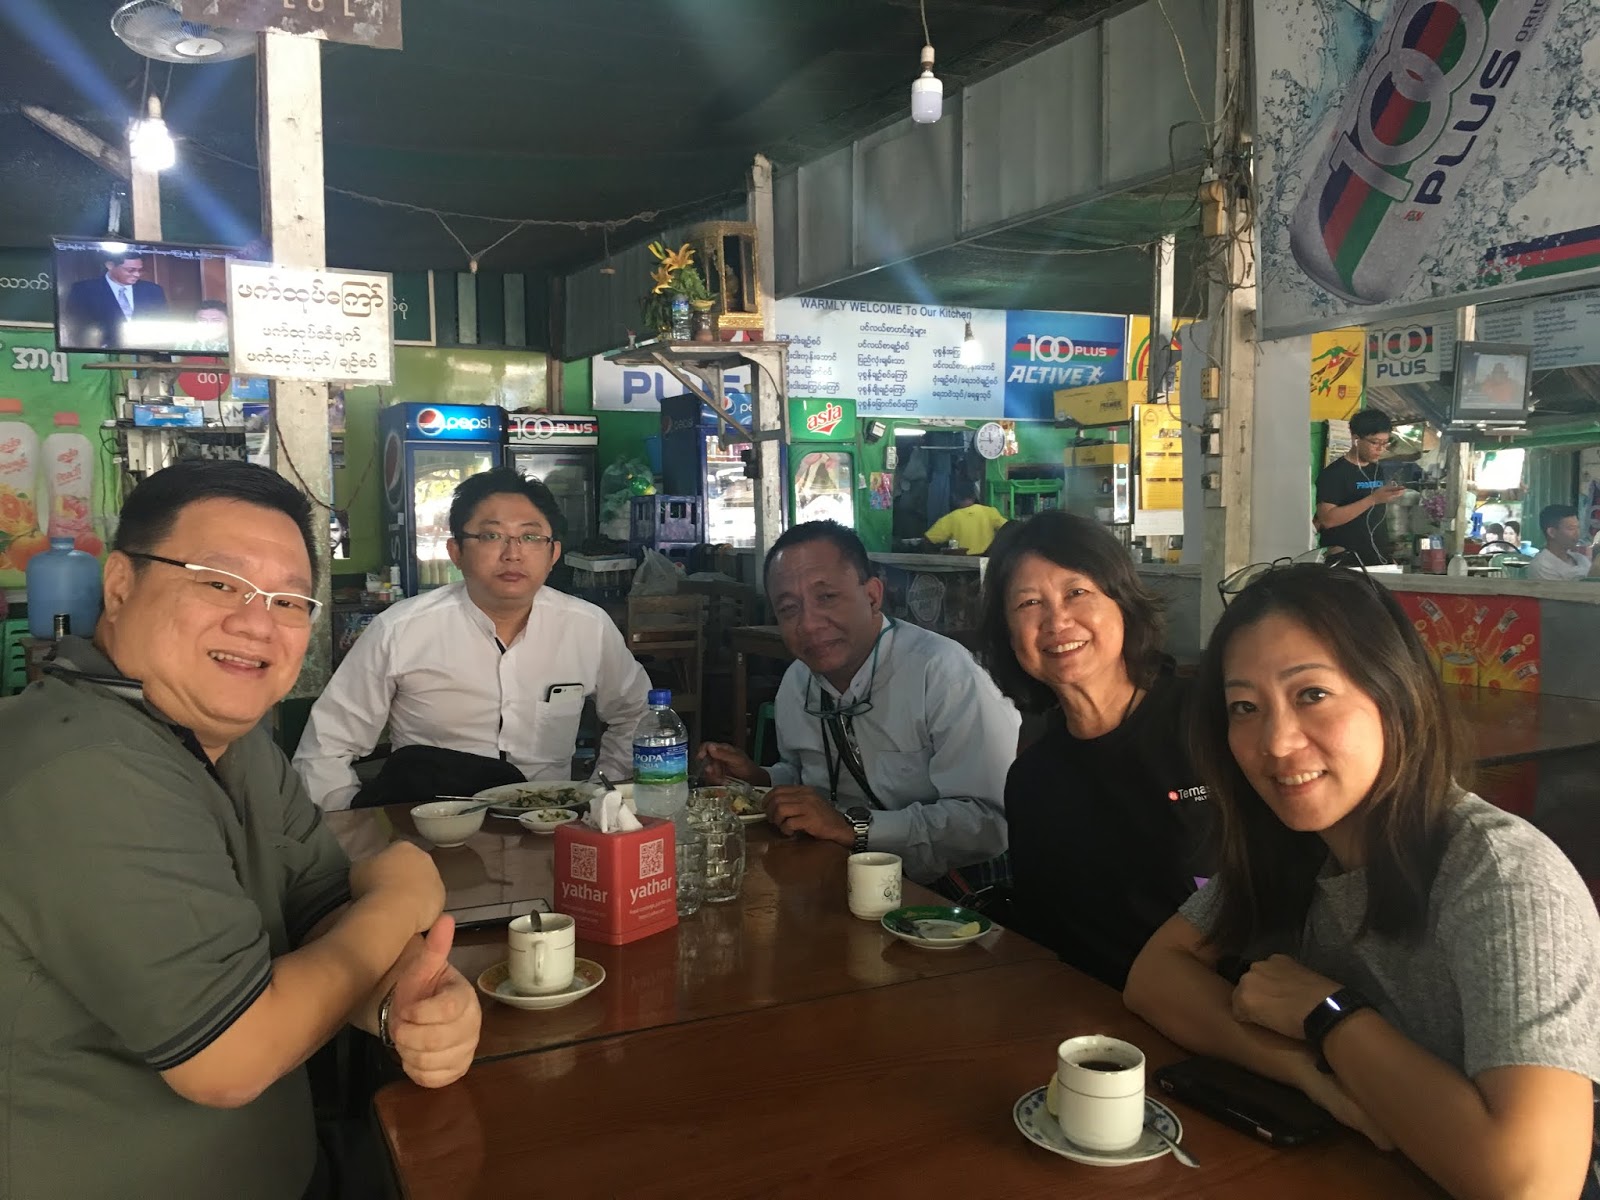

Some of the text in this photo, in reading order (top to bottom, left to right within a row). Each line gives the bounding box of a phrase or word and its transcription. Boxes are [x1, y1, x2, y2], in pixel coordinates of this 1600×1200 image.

[1413, 49, 1521, 205] PLUS
[800, 298, 972, 319] WARMLY WELCOME To Our Kitchen
[1075, 346, 1107, 357] PLUS
[1375, 324, 1428, 362] 100
[1007, 365, 1085, 385] ACTIVE
[1377, 359, 1427, 378] PLUS
[444, 416, 491, 431] pepsi
[807, 402, 842, 430] asia
[513, 417, 594, 440] 100 PLUS
[635, 753, 664, 763] POPA
[1178, 785, 1208, 800] Tema
[562, 881, 608, 903] yathar
[629, 877, 673, 905] yathar
